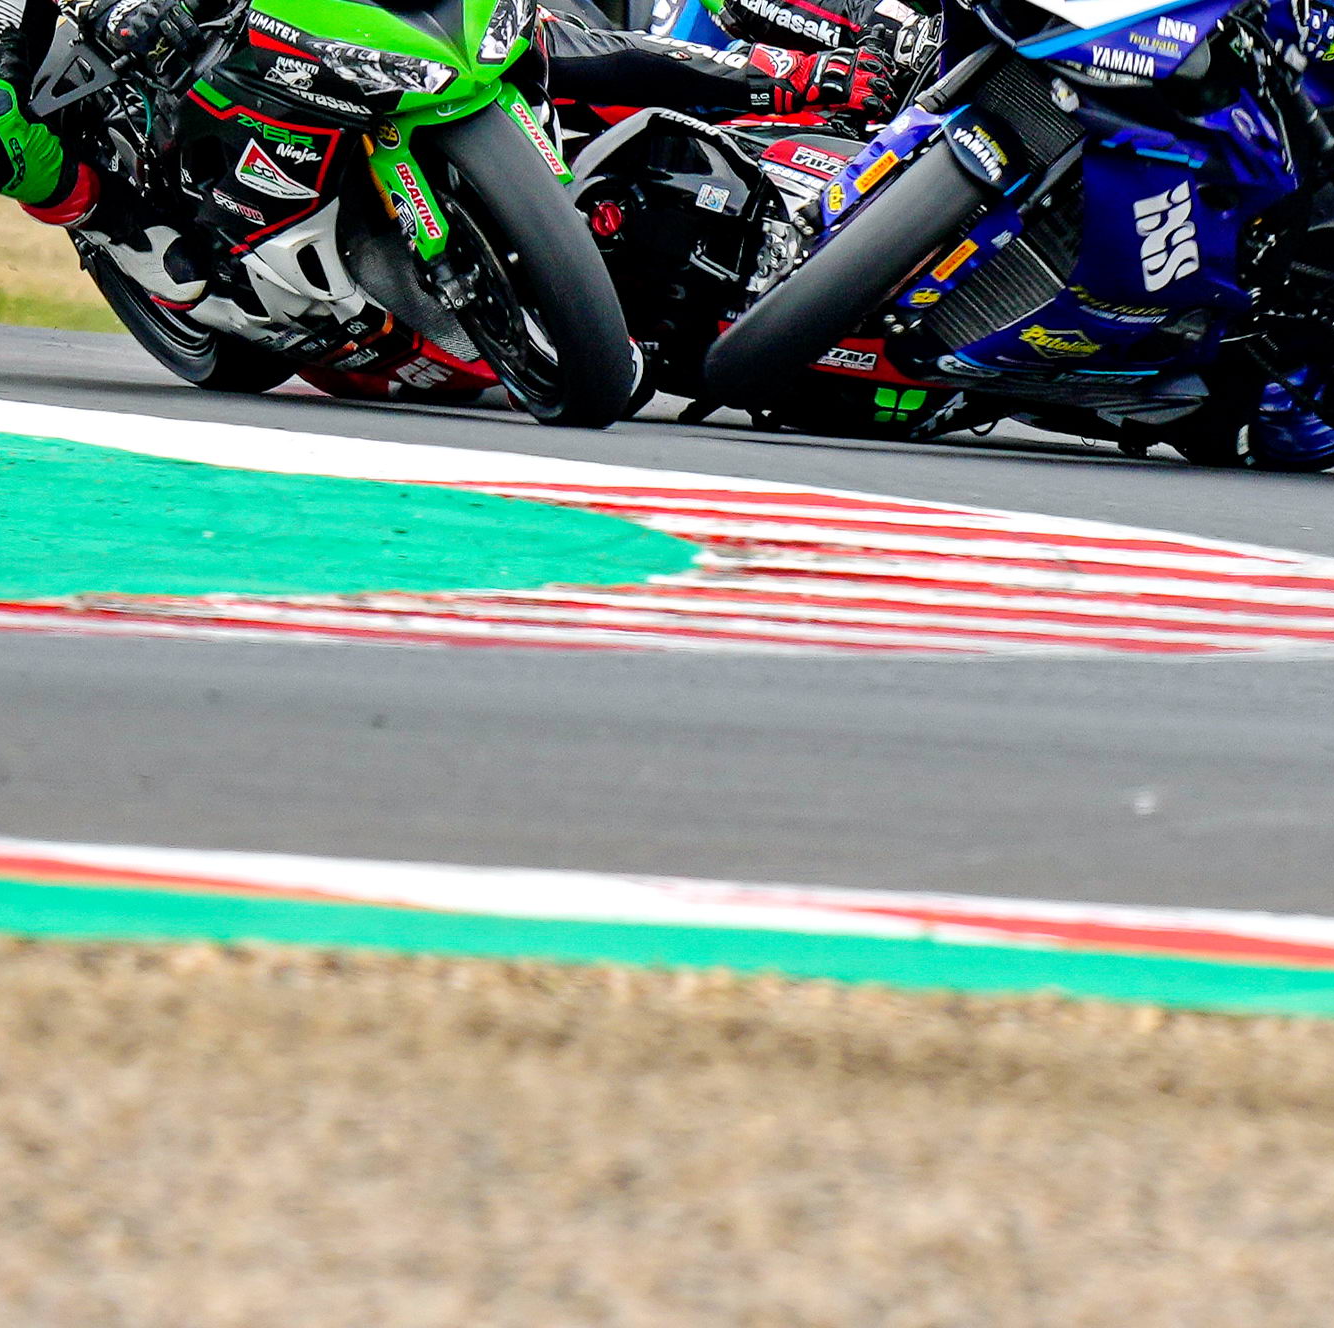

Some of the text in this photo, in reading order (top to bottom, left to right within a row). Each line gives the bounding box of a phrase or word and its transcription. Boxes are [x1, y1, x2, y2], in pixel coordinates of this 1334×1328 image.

[249, 10, 301, 44] UMATEX
[1092, 44, 1155, 78] YAMAHA
[275, 142, 323, 164] Ninja
[510, 102, 567, 177] BRAKING
[953, 127, 1004, 183] YAMAHA
[394, 162, 443, 240] BRAKING
